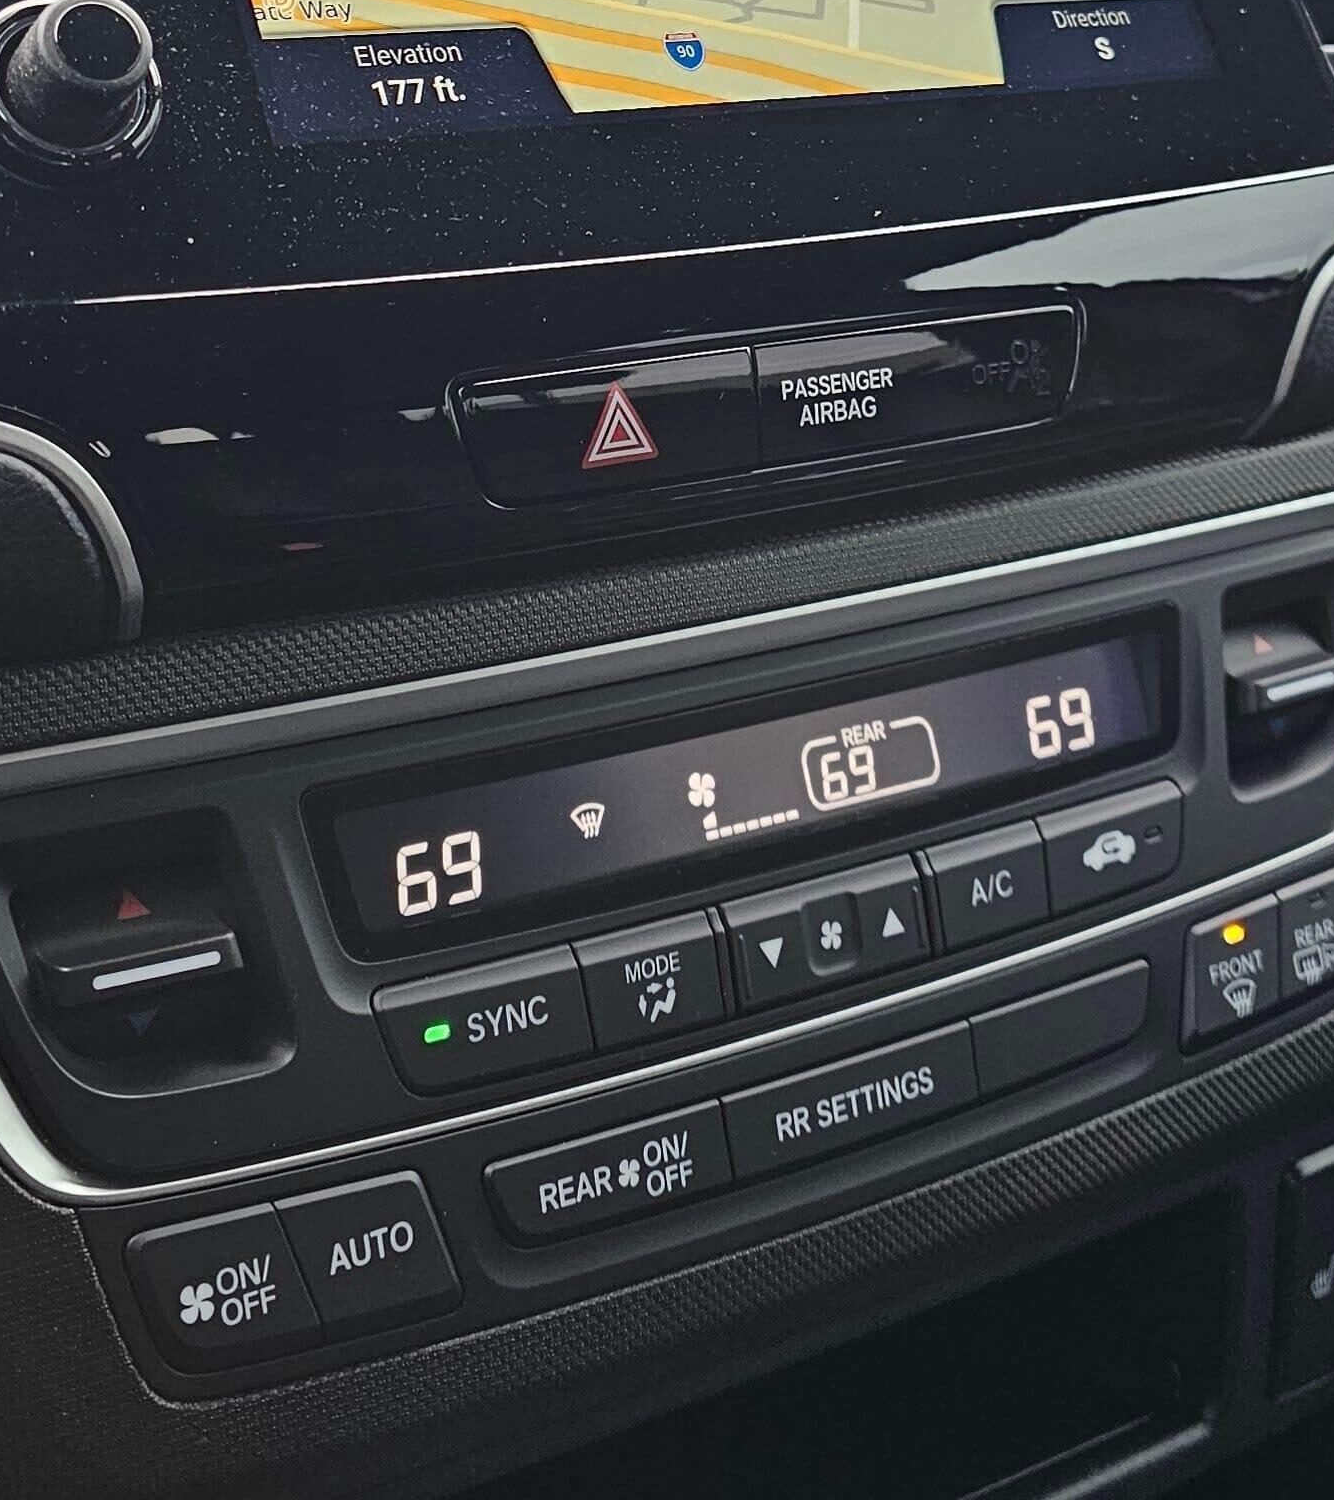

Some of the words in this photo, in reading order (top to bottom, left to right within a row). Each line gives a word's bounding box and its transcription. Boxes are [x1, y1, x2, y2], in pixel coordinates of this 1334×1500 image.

[299, 0, 351, 22] Way
[1052, 8, 1131, 29] Direction
[353, 43, 463, 67] Elevation
[677, 45, 695, 58] 90
[1094, 37, 1115, 60] S
[371, 78, 425, 106] 177
[433, 76, 467, 102] ft.
[780, 367, 893, 400] PASSENGER
[799, 395, 877, 426] AIRBAG
[840, 719, 887, 749] REAR
[1026, 686, 1096, 760] 69
[820, 744, 876, 802] 69
[396, 830, 483, 917] 69
[971, 870, 1013, 907] A/C
[625, 951, 681, 985] MODE
[1208, 949, 1264, 985] FRONT
[467, 995, 549, 1043] SYNC
[775, 1104, 812, 1142] RR
[817, 1066, 934, 1130] SETTINGS
[643, 1131, 689, 1168] ON/
[539, 1166, 614, 1214] REAR
[646, 1159, 693, 1198] OFF
[329, 1220, 414, 1275] AUTO
[215, 1254, 271, 1297] ON/
[220, 1284, 277, 1327] OFF
